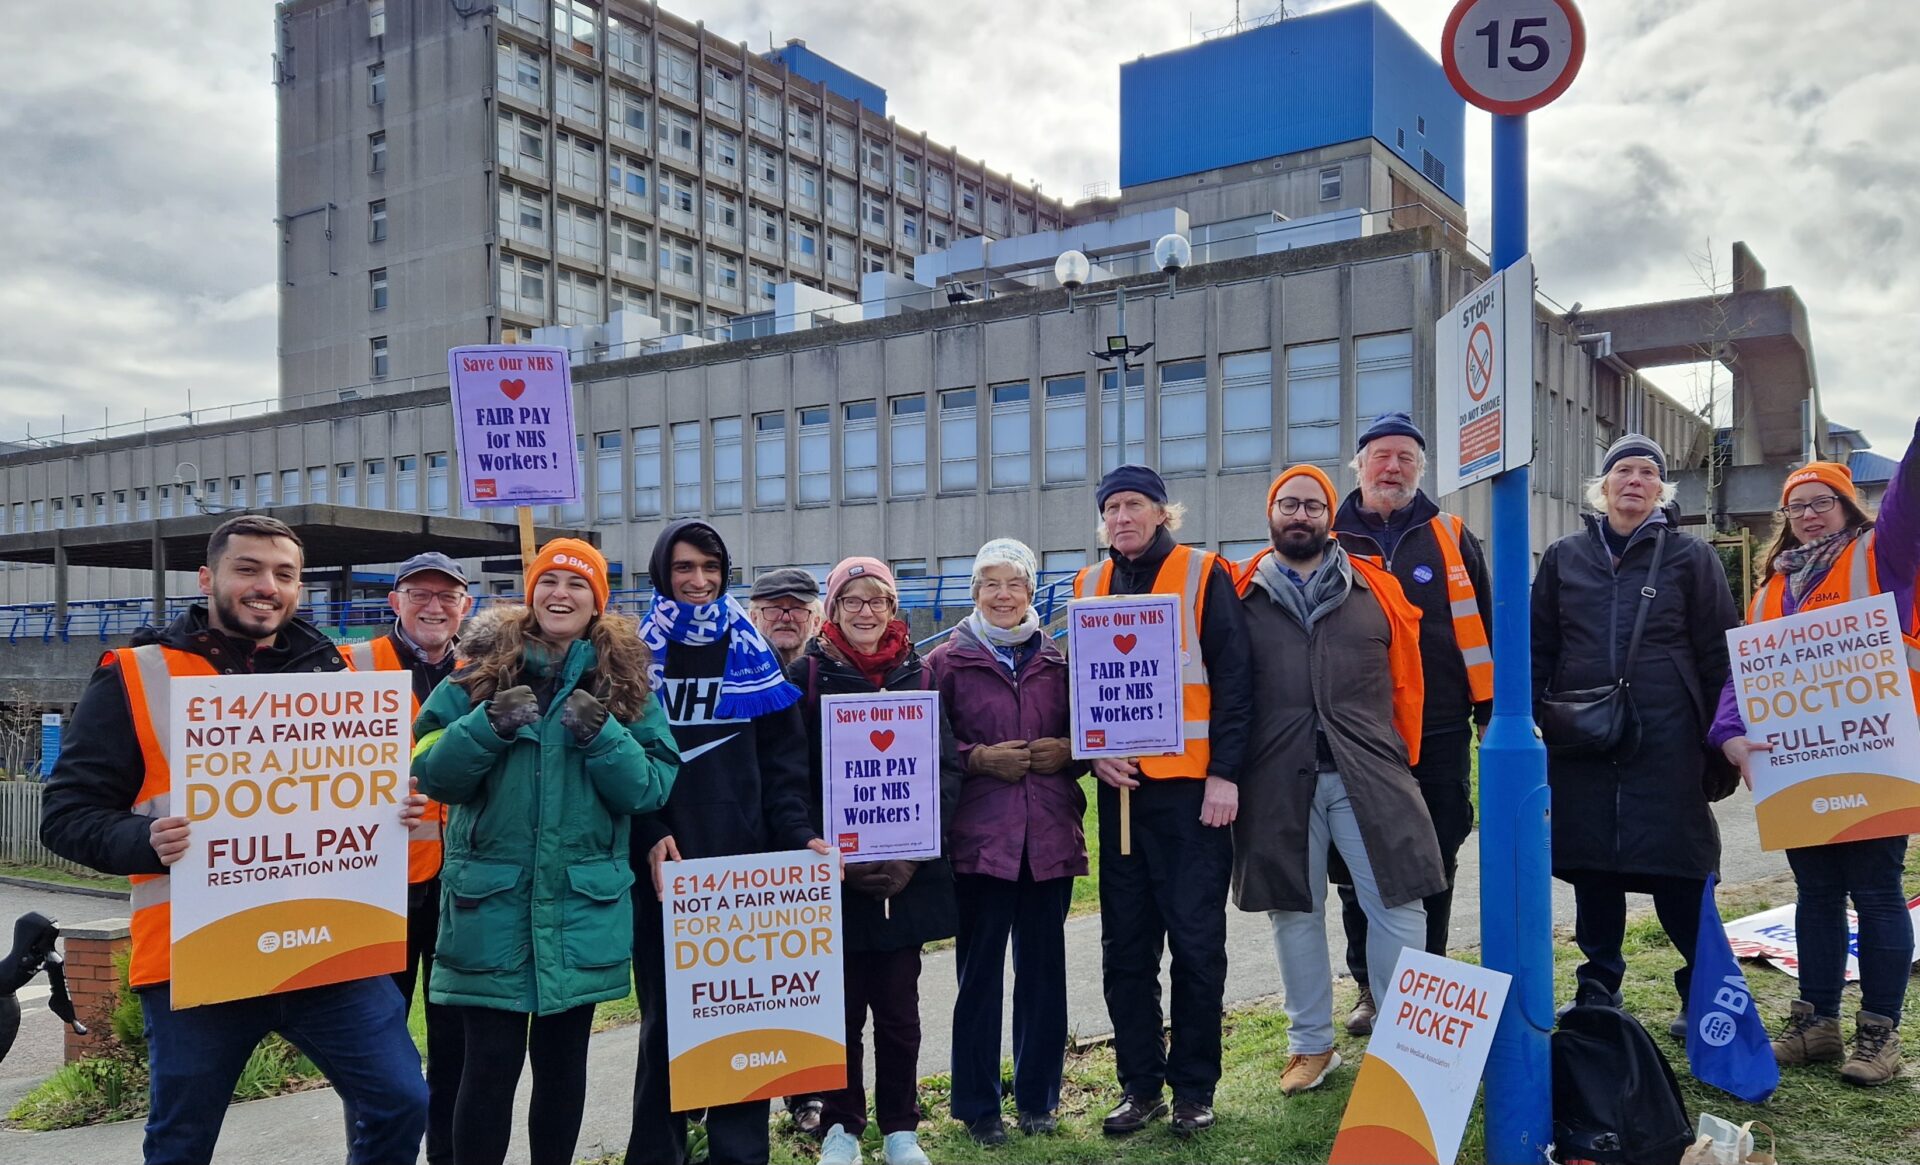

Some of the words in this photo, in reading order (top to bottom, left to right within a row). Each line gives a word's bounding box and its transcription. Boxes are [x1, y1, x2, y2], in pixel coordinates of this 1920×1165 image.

[1476, 17, 1550, 72] 15
[1463, 291, 1494, 328] STOP!
[464, 357, 494, 372] Save
[499, 356, 523, 371] Our
[528, 356, 554, 371] NHS
[476, 408, 514, 425] FAIR
[520, 408, 550, 424] PAY
[1460, 414, 1467, 426] DO
[1468, 407, 1479, 420] NOT
[1480, 396, 1500, 415] SMOKE
[487, 431, 510, 448] for
[516, 431, 546, 447] NHS
[478, 453, 548, 471] Workers
[569, 556, 594, 576] BMA
[1816, 592, 1840, 602] BMA
[1081, 614, 1109, 628] Save
[1114, 612, 1135, 627] Our
[1140, 610, 1164, 625] NHS
[1738, 616, 1858, 657] £14/HOUR
[1866, 609, 1888, 628] IS
[1740, 656, 1774, 674] NOT
[1780, 653, 1792, 668] A
[1796, 644, 1834, 663] FAIR
[1838, 630, 1892, 654] WAGE
[1090, 662, 1125, 680] FAIR
[1130, 660, 1159, 677] PAY
[1742, 672, 1786, 694] FOR
[1792, 667, 1807, 686] A
[1811, 648, 1896, 684] JUNIOR
[186, 690, 364, 722] £14/HOUR
[374, 689, 399, 713] IS
[1099, 685, 1120, 701] for
[1126, 682, 1153, 700] NHS
[1746, 670, 1901, 724] DOCTOR
[837, 708, 866, 723] Save
[871, 706, 893, 722] Our
[898, 705, 923, 720] NHS
[1090, 705, 1153, 723] Workers
[186, 726, 241, 748] NOT
[248, 726, 264, 744] A
[272, 722, 326, 743] FAIR
[332, 719, 398, 739] WAGE
[1766, 724, 1836, 754] FULL
[1841, 713, 1890, 742] PAY
[186, 751, 251, 778] FOR
[260, 750, 282, 773] A
[288, 742, 398, 775] JUNIOR
[1770, 744, 1859, 767] RESTORATION
[1863, 736, 1895, 753] NOW
[845, 759, 880, 779] FAIR
[886, 757, 916, 777] PAY
[186, 770, 398, 822] DOCTOR
[854, 785, 876, 802] for
[882, 782, 910, 801] NHS
[1830, 794, 1868, 810] BMA
[844, 805, 910, 826] Workers
[207, 832, 305, 868] FULL
[316, 824, 379, 857] PAY
[208, 860, 333, 887] RESTORATION
[339, 854, 378, 872] NOW
[673, 866, 803, 895] £14/HOUR
[810, 864, 831, 883] IS
[673, 897, 713, 914] NOT
[717, 897, 730, 910] A
[736, 892, 775, 908] FAIR
[780, 886, 831, 904] WAGE
[674, 916, 720, 937] FOR
[728, 914, 743, 932] A
[748, 905, 832, 933] JUNIOR
[282, 926, 332, 949] BMA
[674, 927, 833, 970] DOCTOR
[692, 978, 764, 1005] FULL
[772, 970, 820, 996] PAY
[1399, 968, 1488, 1020] OFFICIAL
[693, 998, 785, 1019] RESTORATION
[790, 994, 820, 1011] NOW
[1396, 1001, 1474, 1048] PICKET
[749, 1050, 787, 1068] BMA
